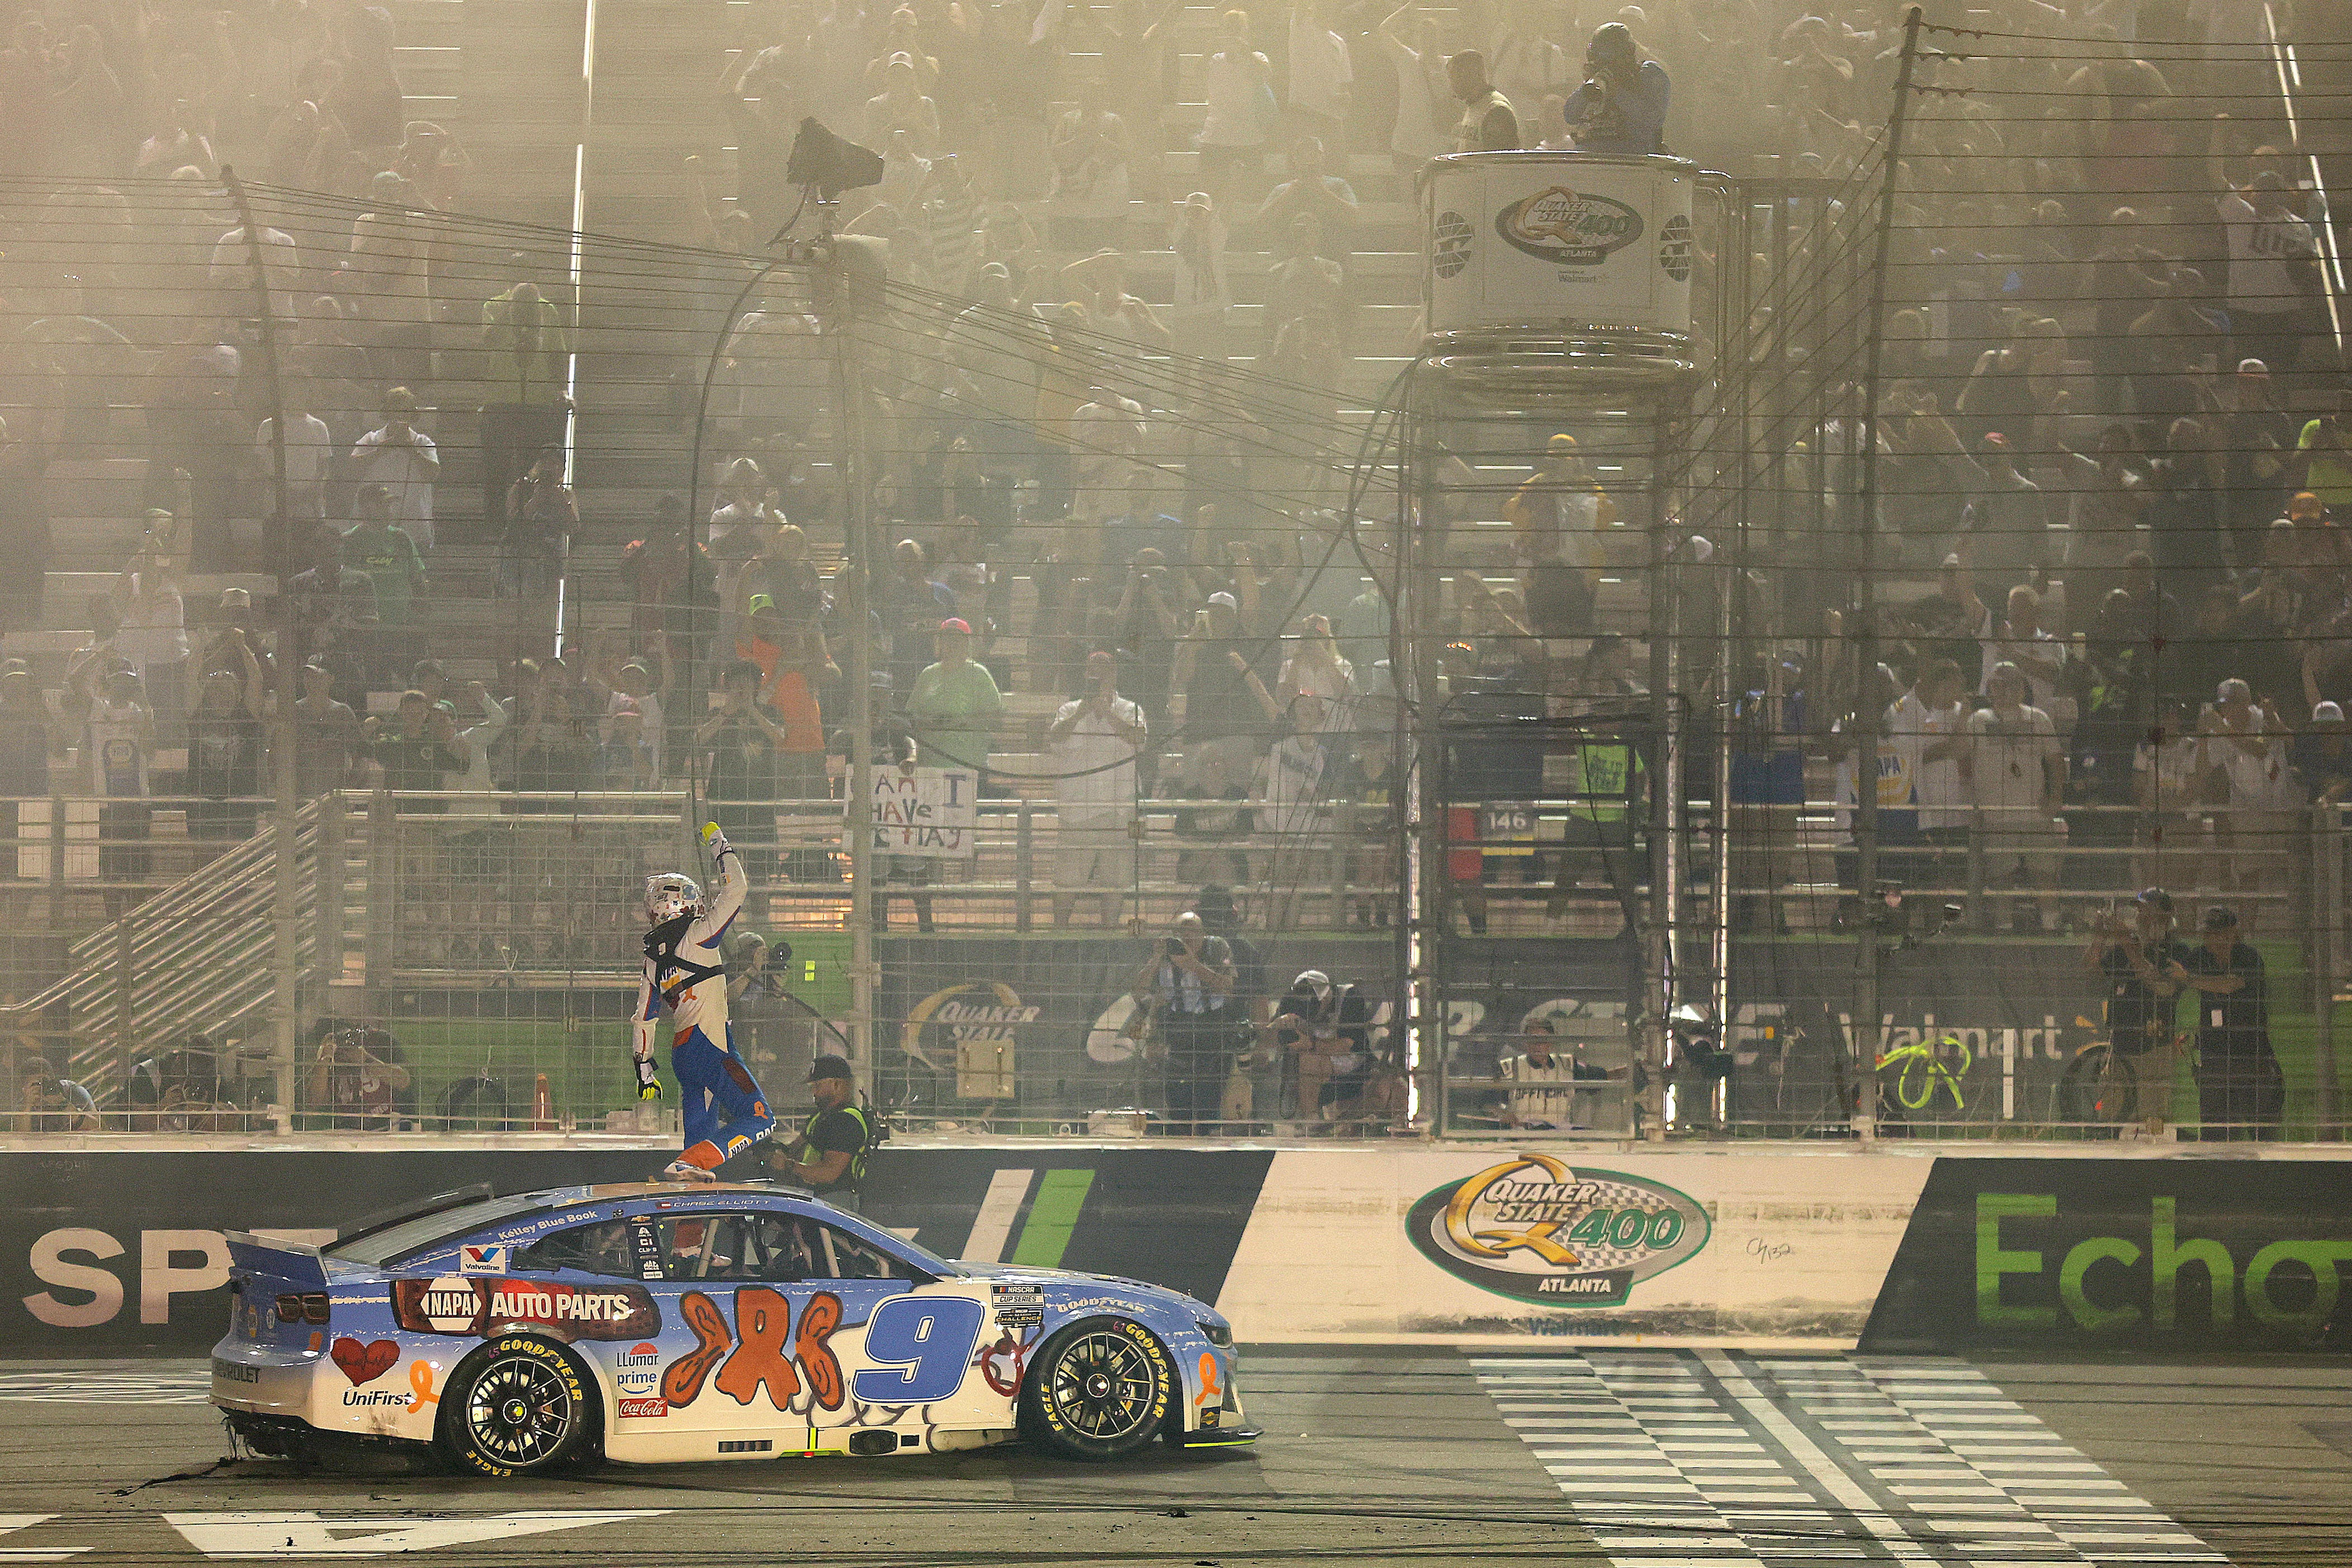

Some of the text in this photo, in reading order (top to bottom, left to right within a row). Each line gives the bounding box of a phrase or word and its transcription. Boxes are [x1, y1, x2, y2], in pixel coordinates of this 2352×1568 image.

[1533, 200, 1592, 213] QUAKER
[1575, 215, 1631, 236] 400
[1559, 249, 1597, 258] ATLANTA
[943, 774, 967, 808] I
[937, 1001, 1040, 1023] QUAKER
[1484, 1179, 1599, 1205] QUAKER
[1495, 1201, 1579, 1223] STATE
[498, 1210, 598, 1240] Kelley Blue Book
[1567, 1209, 1686, 1250] 400
[1538, 1277, 1613, 1294] ATLANTA
[430, 1292, 631, 1320] NAPA AUTO PARTS
[617, 1352, 659, 1367] LLumar
[851, 1295, 985, 1404] 9
[500, 1339, 584, 1401] GOODYEAR
[617, 1371, 657, 1387] prime
[1125, 1323, 1171, 1419] GOODYEAR
[343, 1390, 413, 1406] UniFirst
[619, 1399, 666, 1417] Coca-Cola
[1040, 1382, 1064, 1432] EAGLE
[466, 1449, 513, 1477] EAGLE
